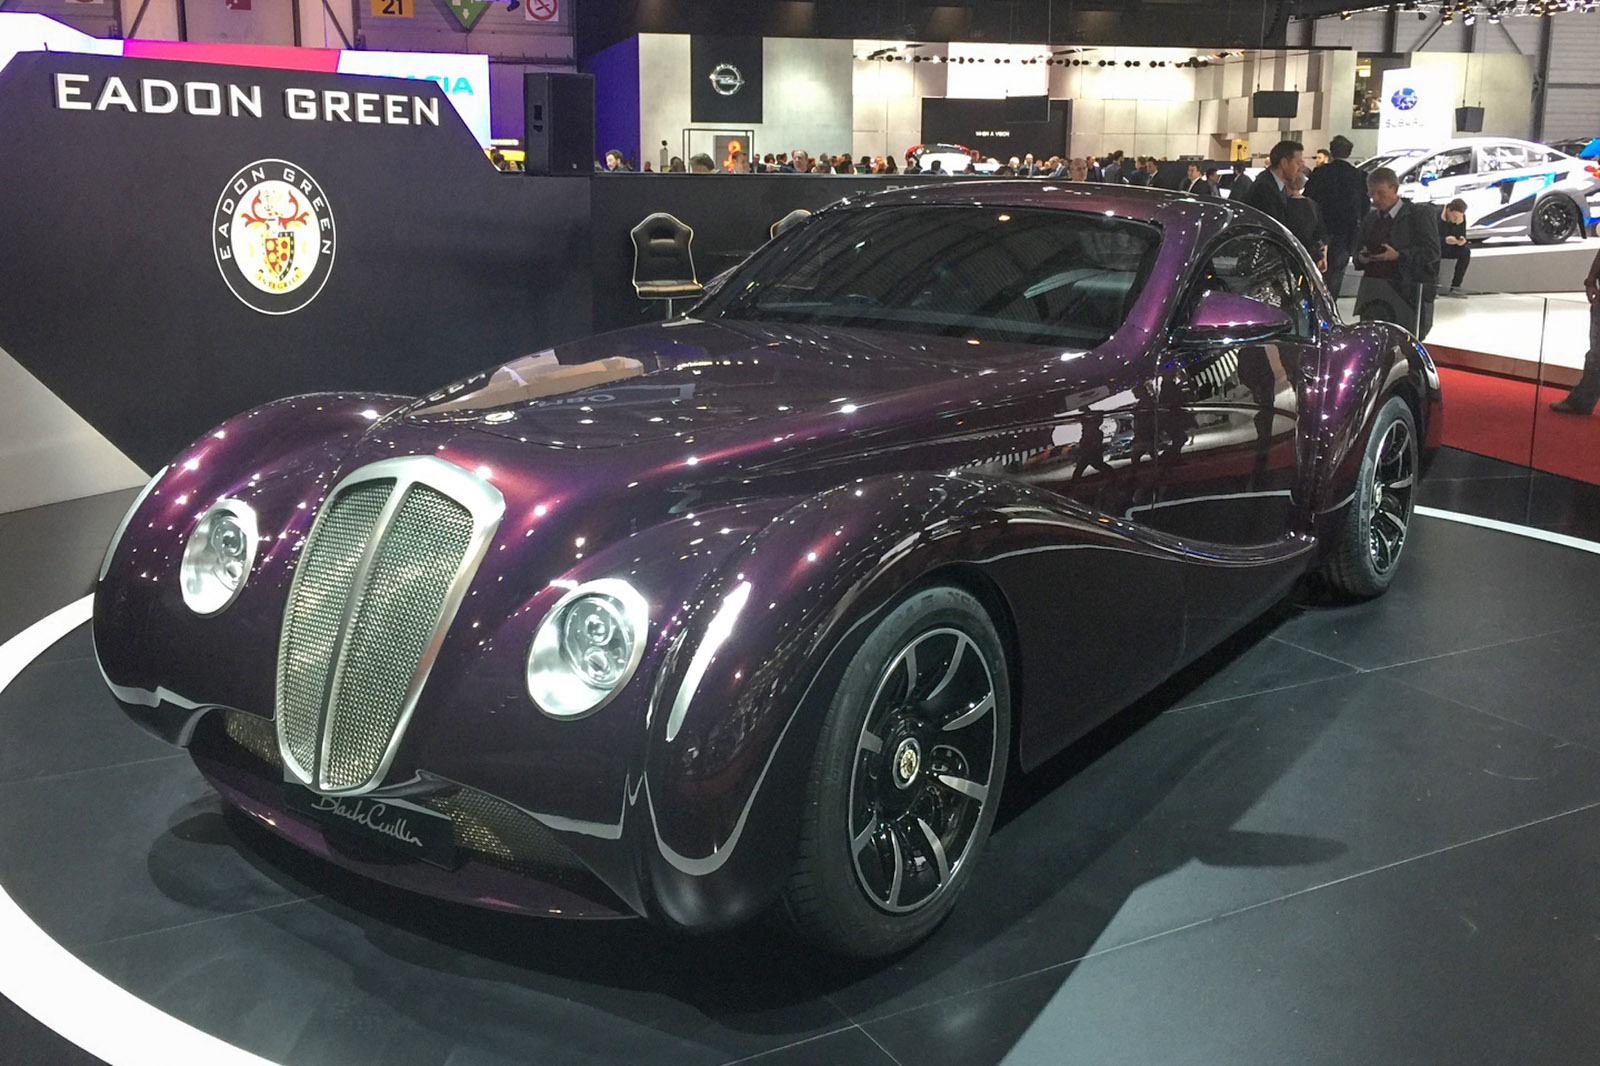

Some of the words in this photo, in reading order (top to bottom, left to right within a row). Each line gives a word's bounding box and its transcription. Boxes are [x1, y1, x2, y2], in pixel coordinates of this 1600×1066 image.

[381, 0, 403, 15] 21
[55, 73, 262, 118] EADON
[284, 88, 440, 126] GREEN
[218, 167, 265, 260] EADON
[283, 168, 332, 254] GREEN
